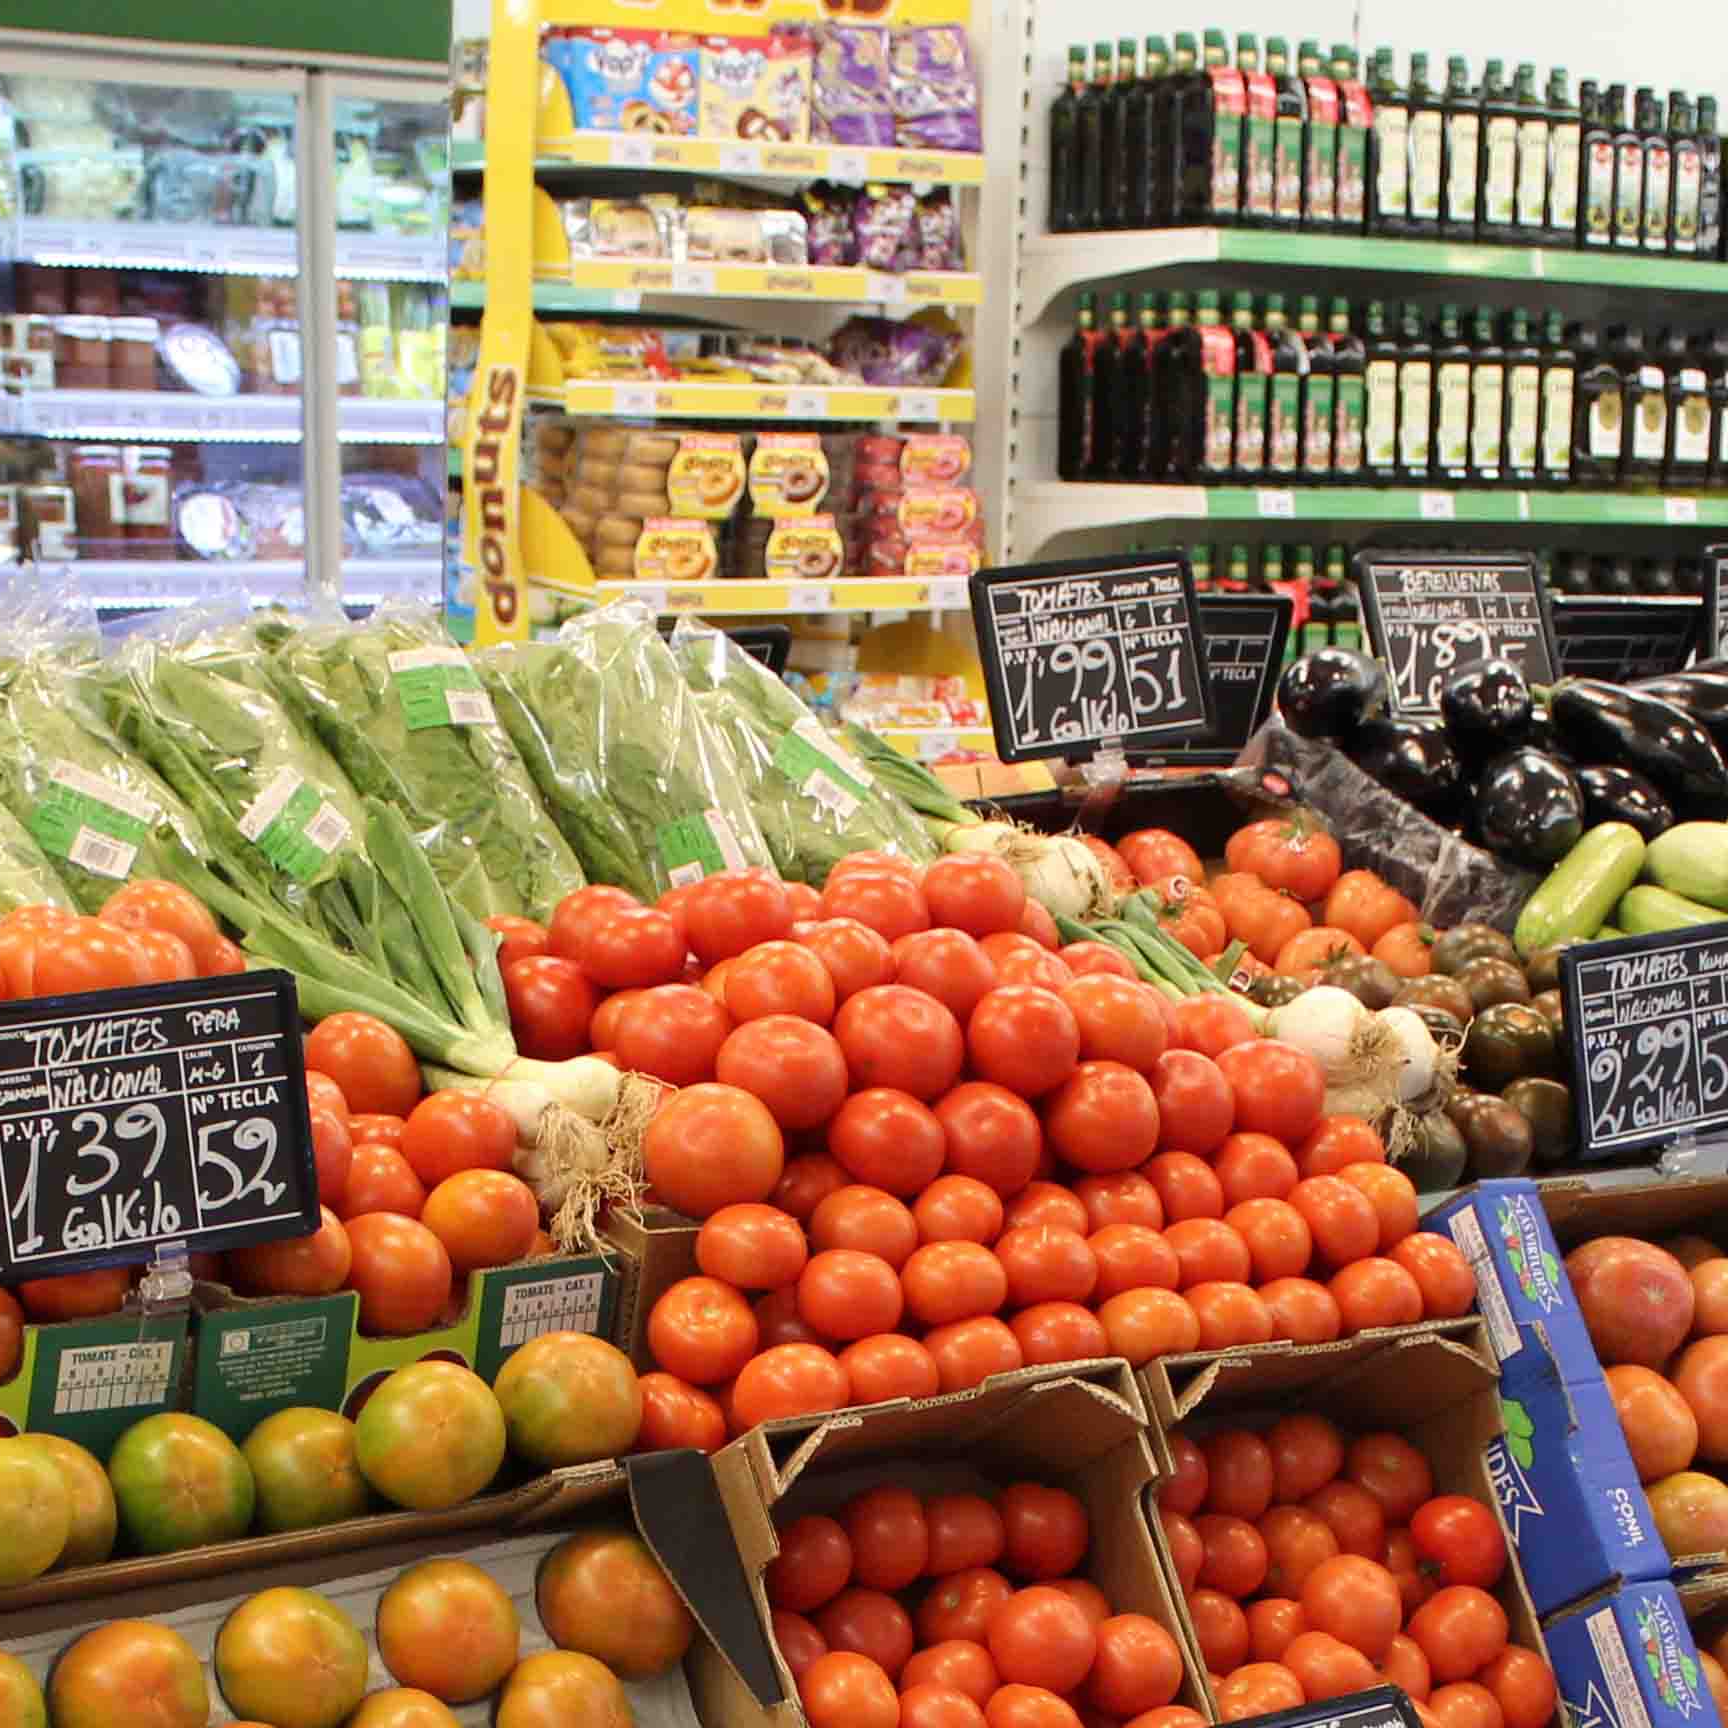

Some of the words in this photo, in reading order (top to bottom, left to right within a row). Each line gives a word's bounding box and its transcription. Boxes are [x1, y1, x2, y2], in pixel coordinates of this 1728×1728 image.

[472, 367, 517, 626] donuts
[1018, 580, 1106, 614] TOMATES
[1143, 631, 1184, 648] TECLA
[1129, 648, 1187, 714] 51
[1221, 667, 1257, 681] TECLA
[1606, 951, 1688, 990] TOMATES
[24, 1016, 169, 1067] TOMATES
[186, 1008, 240, 1036] PERA
[53, 1064, 167, 1107] NACIONAL
[219, 1085, 279, 1110] TECLA
[198, 1117, 286, 1210] 52
[515, 1285, 555, 1299] TOMATE
[72, 1352, 116, 1365] TOMATE
[1614, 1486, 1646, 1548] CONIL
